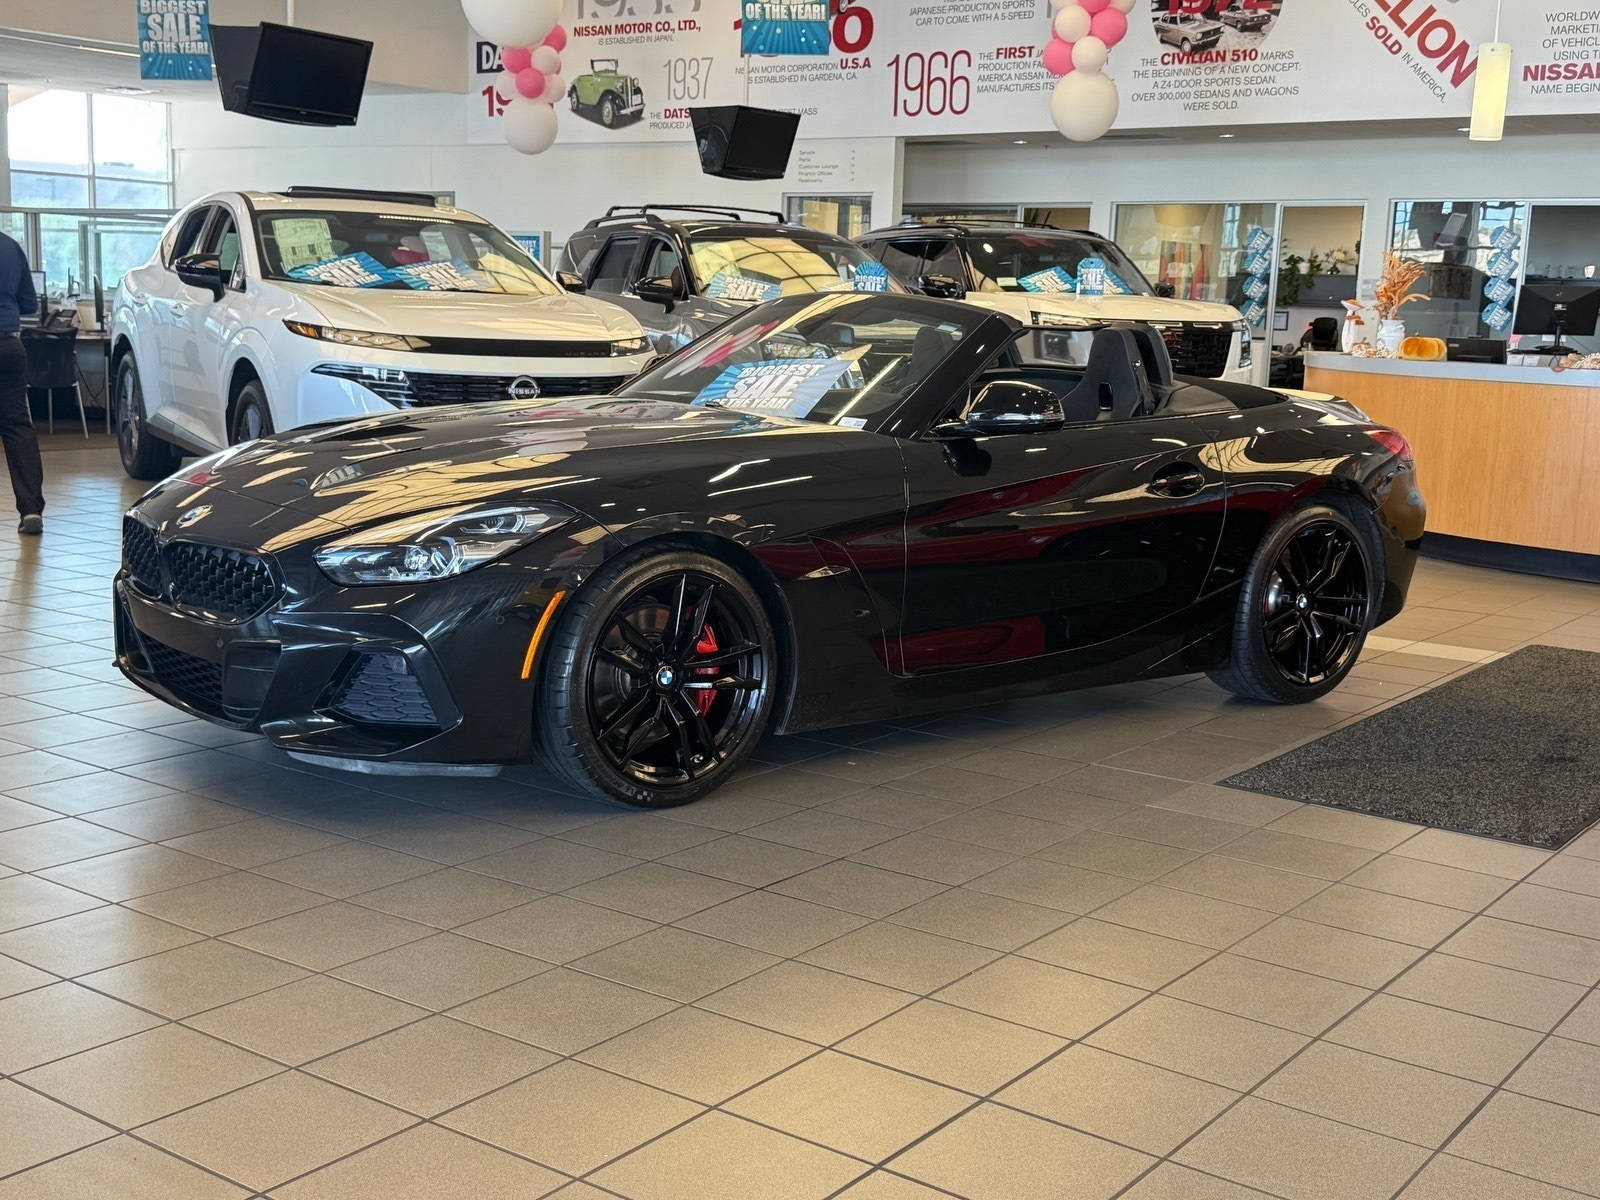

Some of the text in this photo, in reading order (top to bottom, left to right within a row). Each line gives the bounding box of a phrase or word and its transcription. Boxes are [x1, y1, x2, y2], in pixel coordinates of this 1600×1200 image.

[140, 0, 206, 14] BIGGEST
[1002, 0, 1035, 9] SPORTS
[746, 3, 826, 21] OF THE YEAR!
[916, 10, 1034, 26] CAR TO COME WITH A 5-SPEED
[147, 12, 202, 42] SALE
[574, 20, 701, 37] NISSAN MOTOR CO., LTD.,
[1550, 24, 1600, 35] MARKETI
[142, 41, 208, 54] OF THE YEAR!
[605, 36, 646, 45] ESTABLISHED
[1542, 39, 1558, 49] OF
[979, 52, 994, 60] THE
[996, 46, 1035, 60] FIRST
[1141, 48, 1294, 67] THE CIVILIAN 510 MARKS
[1366, 16, 1402, 55] SOLD
[1401, 52, 1412, 65] IN
[1410, 64, 1447, 103] AMERICA.
[1553, 50, 1600, 61] USING T
[761, 65, 786, 74] MOTOR
[787, 63, 838, 72] CORPORATION
[840, 57, 871, 69] U.S.A
[978, 61, 1031, 72] PRODUCTION
[1133, 69, 1150, 79] THE
[1152, 67, 1201, 78] BEGINNING
[1204, 67, 1217, 76] OF
[1219, 66, 1226, 74] A
[1227, 64, 1251, 74] NEW
[663, 57, 714, 100] 1937
[754, 74, 799, 84] ESTABLISHED
[887, 50, 972, 117] 1966
[977, 73, 1012, 82] AMERICA
[1014, 72, 1044, 80] NISSAN
[1153, 81, 1159, 89] A
[1204, 77, 1242, 87] SPORTS
[1244, 75, 1277, 85] SEDAN.
[977, 82, 1055, 93] MANUFACTURES ITS
[1131, 86, 1299, 101] OVER 300,000 SEDANS AND WAGONS
[1531, 84, 1563, 94] NAME
[1183, 100, 1238, 110] WERE SOLD.
[305, 257, 358, 277] BIGGEST
[406, 262, 455, 276] BIGGEST
[320, 264, 370, 285] SALE
[420, 269, 468, 286] SALE
[855, 274, 885, 284] BIGGEST
[1082, 274, 1101, 284] SALE
[726, 276, 771, 291] BIGGEST
[725, 283, 764, 300] SALE
[736, 364, 825, 378] BIGGEST
[726, 375, 806, 398] SALE
[726, 398, 752, 409] THE
[750, 398, 794, 409] YEAR!
